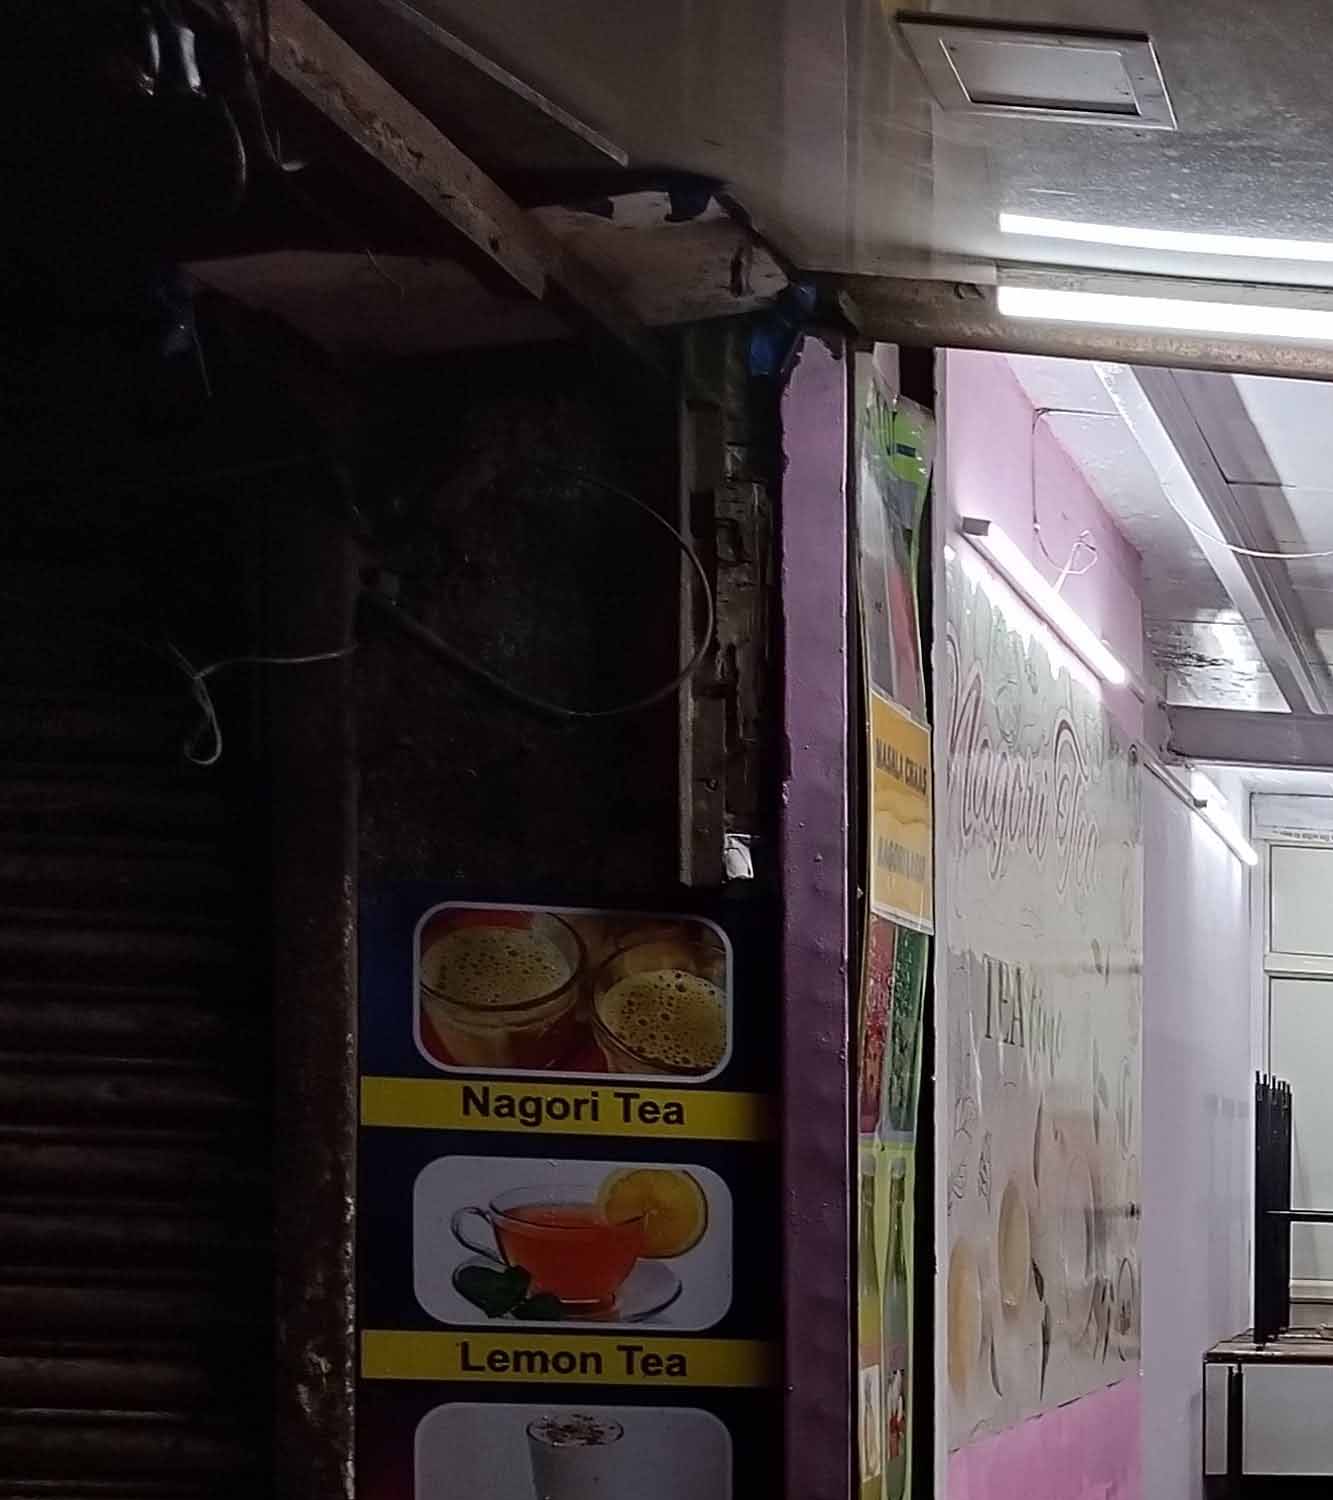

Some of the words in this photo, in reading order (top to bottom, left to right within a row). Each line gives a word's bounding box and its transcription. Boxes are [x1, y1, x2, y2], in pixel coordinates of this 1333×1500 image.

[983, 953, 1024, 1048] TEA
[461, 1085, 600, 1128] Nagori
[615, 1091, 685, 1126] Tea
[460, 1341, 602, 1376] Lemon
[618, 1345, 688, 1378] Tea
